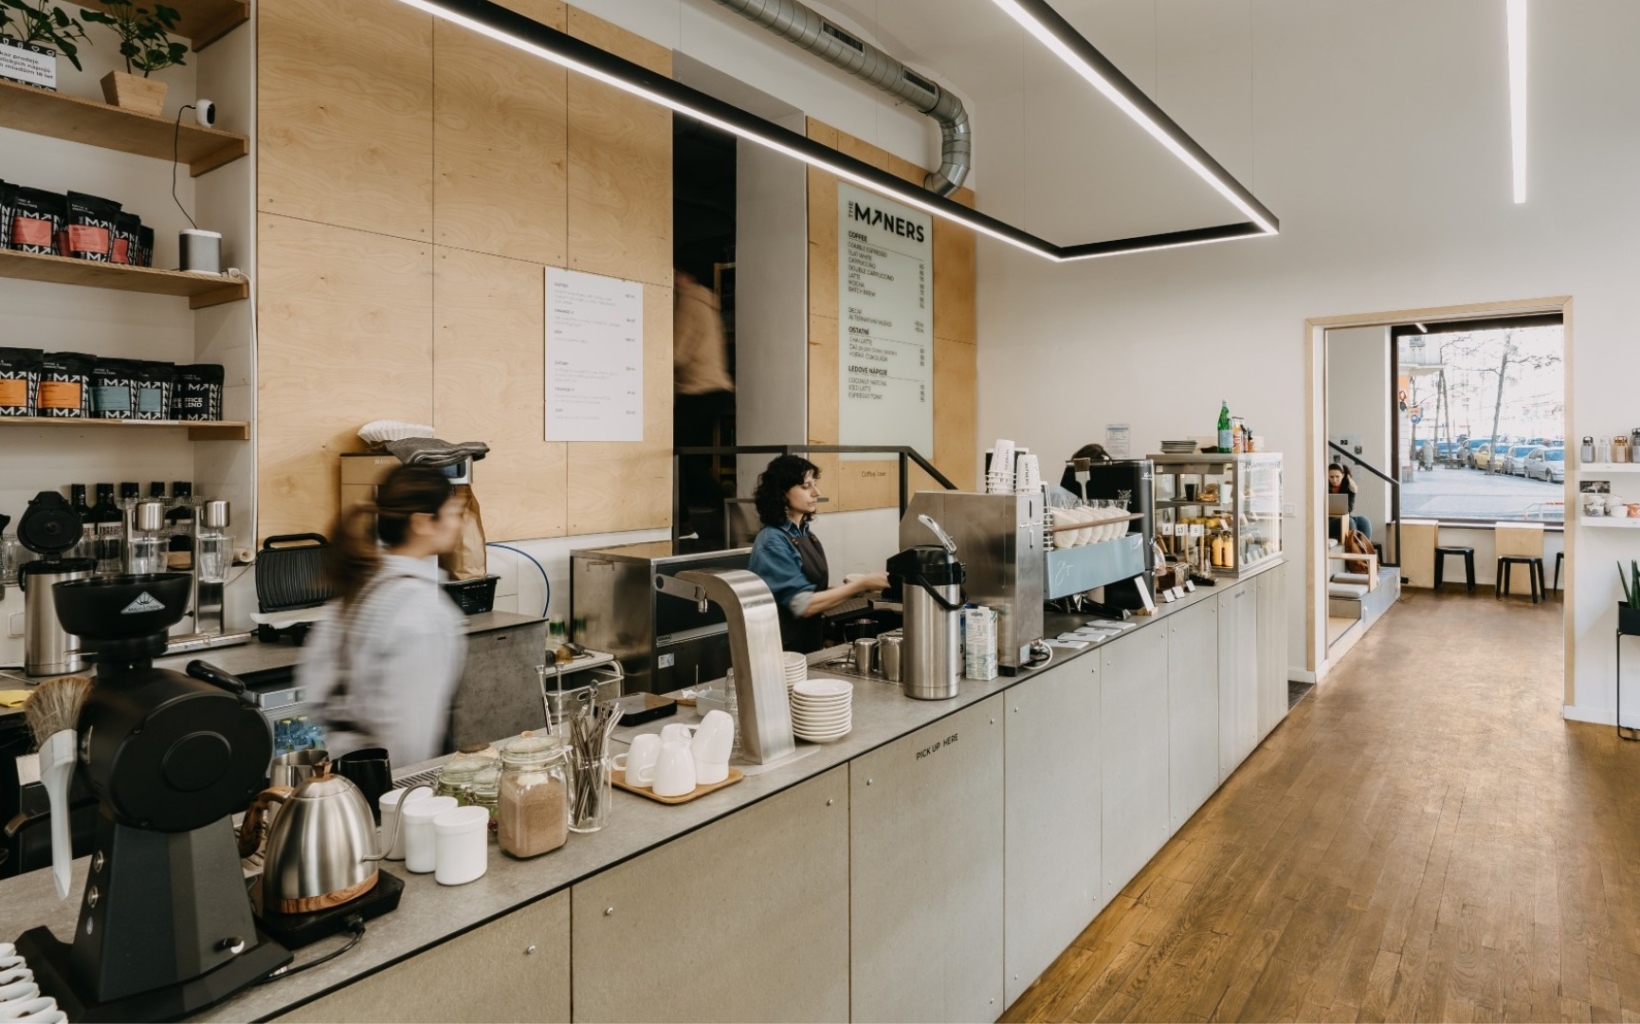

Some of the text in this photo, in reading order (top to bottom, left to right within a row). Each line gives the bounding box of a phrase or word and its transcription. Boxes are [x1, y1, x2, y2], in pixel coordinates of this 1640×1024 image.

[848, 230, 868, 242] COFFEE
[866, 246, 887, 258] ESPRESSO
[848, 257, 876, 269] CAPPUCCINO
[848, 264, 894, 281] DOUBLE CAPPUCCINO
[916, 733, 958, 761] PICK UP HERE
